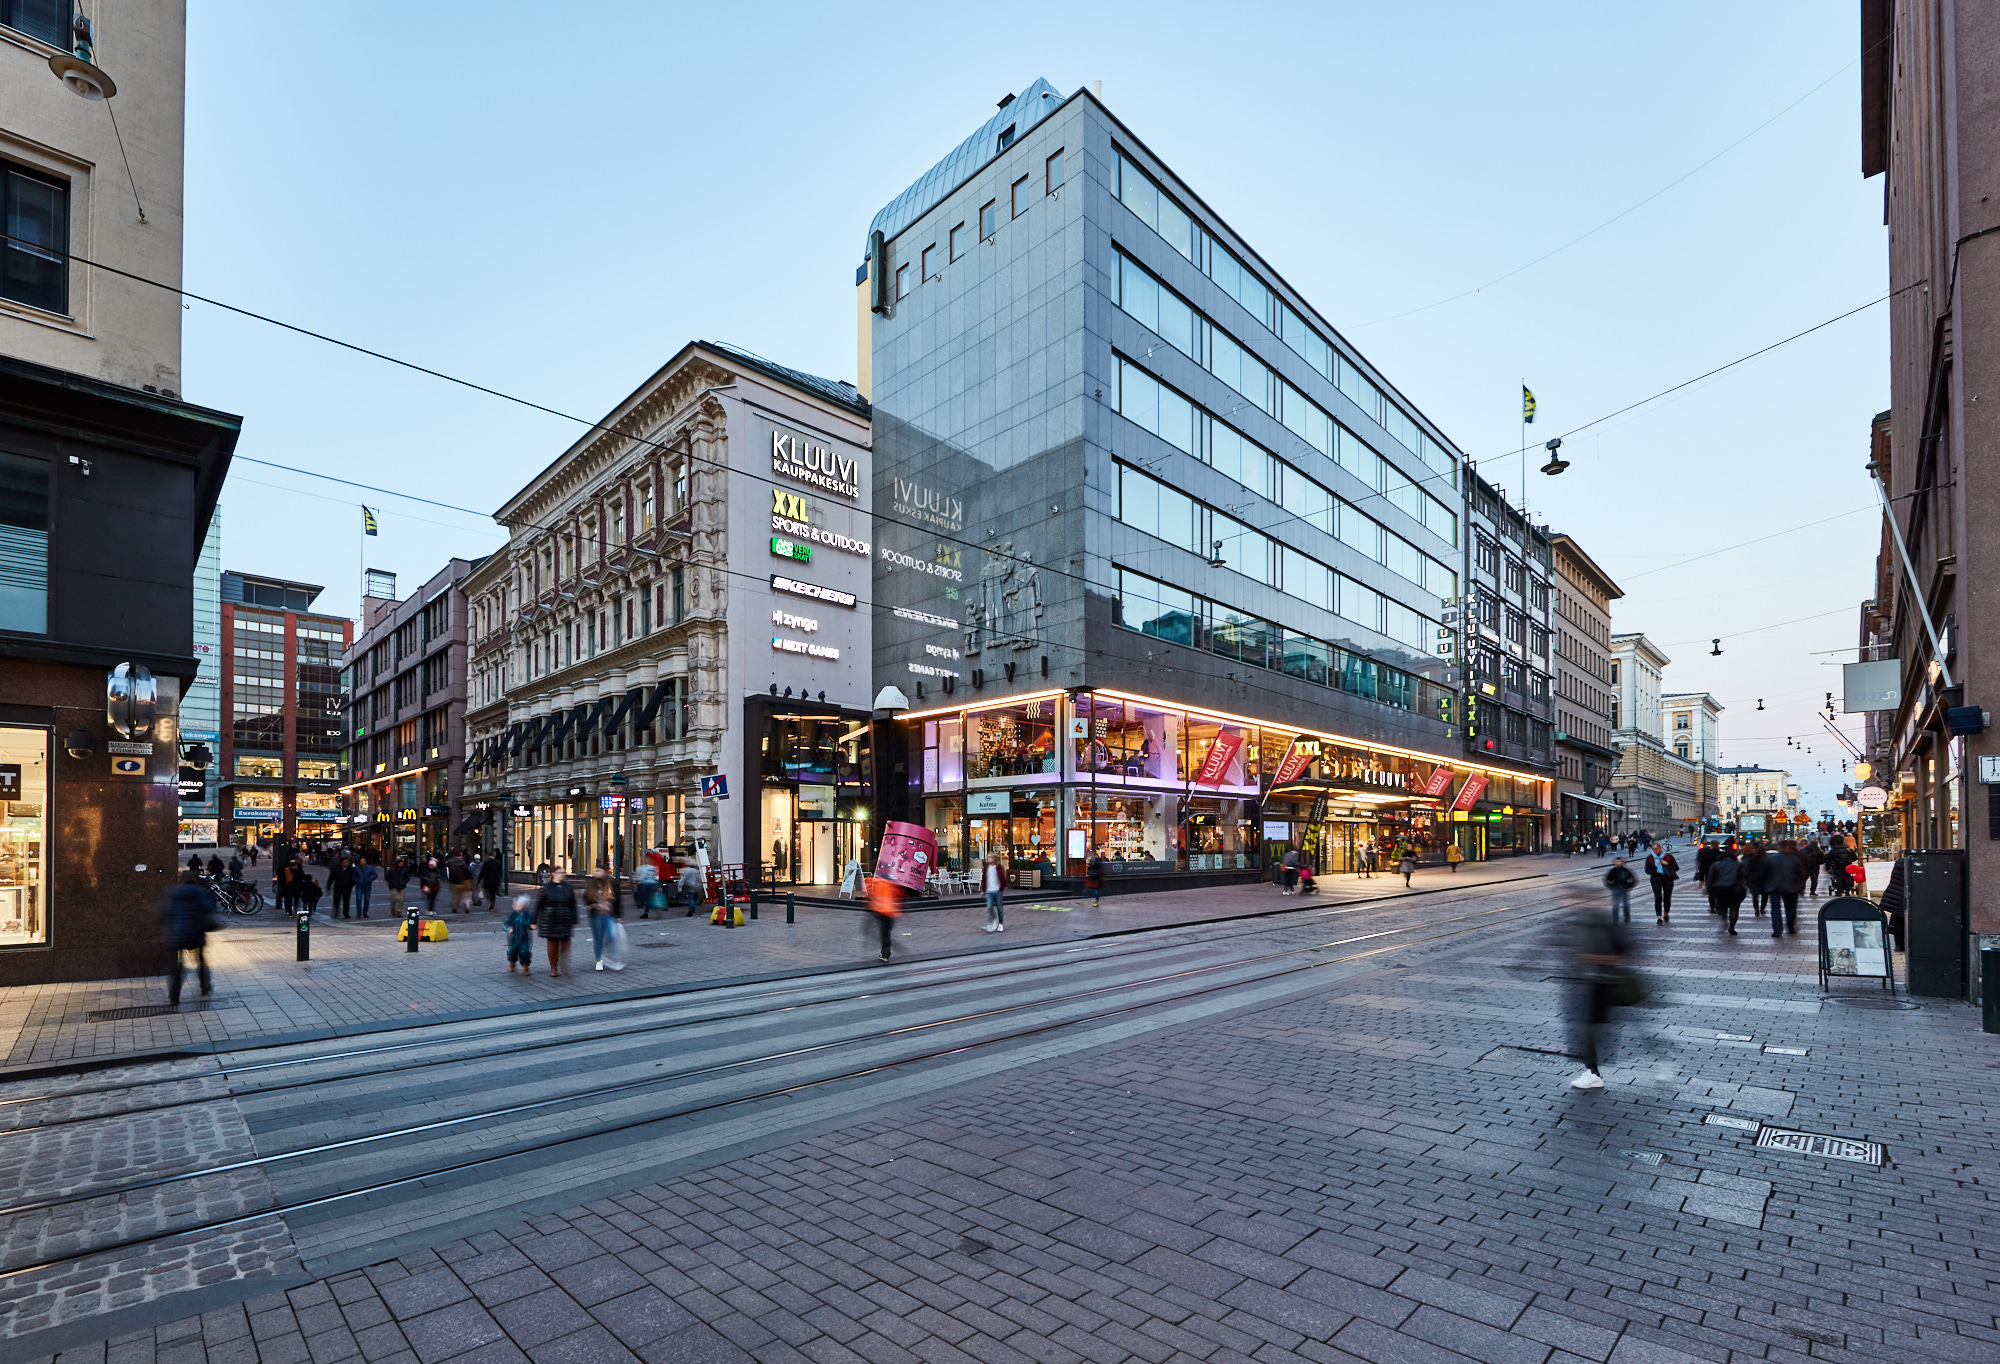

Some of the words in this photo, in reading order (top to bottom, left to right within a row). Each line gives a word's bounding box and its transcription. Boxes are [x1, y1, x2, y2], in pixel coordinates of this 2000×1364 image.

[773, 430, 858, 485] KLUUVI
[773, 459, 859, 498] KAUPPAKESKUS
[772, 489, 809, 522] XXL
[772, 515, 810, 538] SPORTS
[810, 527, 820, 541] &
[820, 530, 871, 556] OUTDOOR
[793, 543, 812, 555] VERO
[773, 577, 856, 606] SKECHERS
[783, 613, 818, 632] zynga
[1467, 593, 1476, 679] KLUUVI
[782, 639, 808, 653] NEXT
[808, 643, 840, 659] GAMES
[1468, 695, 1476, 737] XXL
[1203, 743, 1228, 778] KLUUVI
[1294, 741, 1321, 755] XXL
[1364, 768, 1405, 788] KLUUVI
[1302, 824, 1321, 855] XXL
